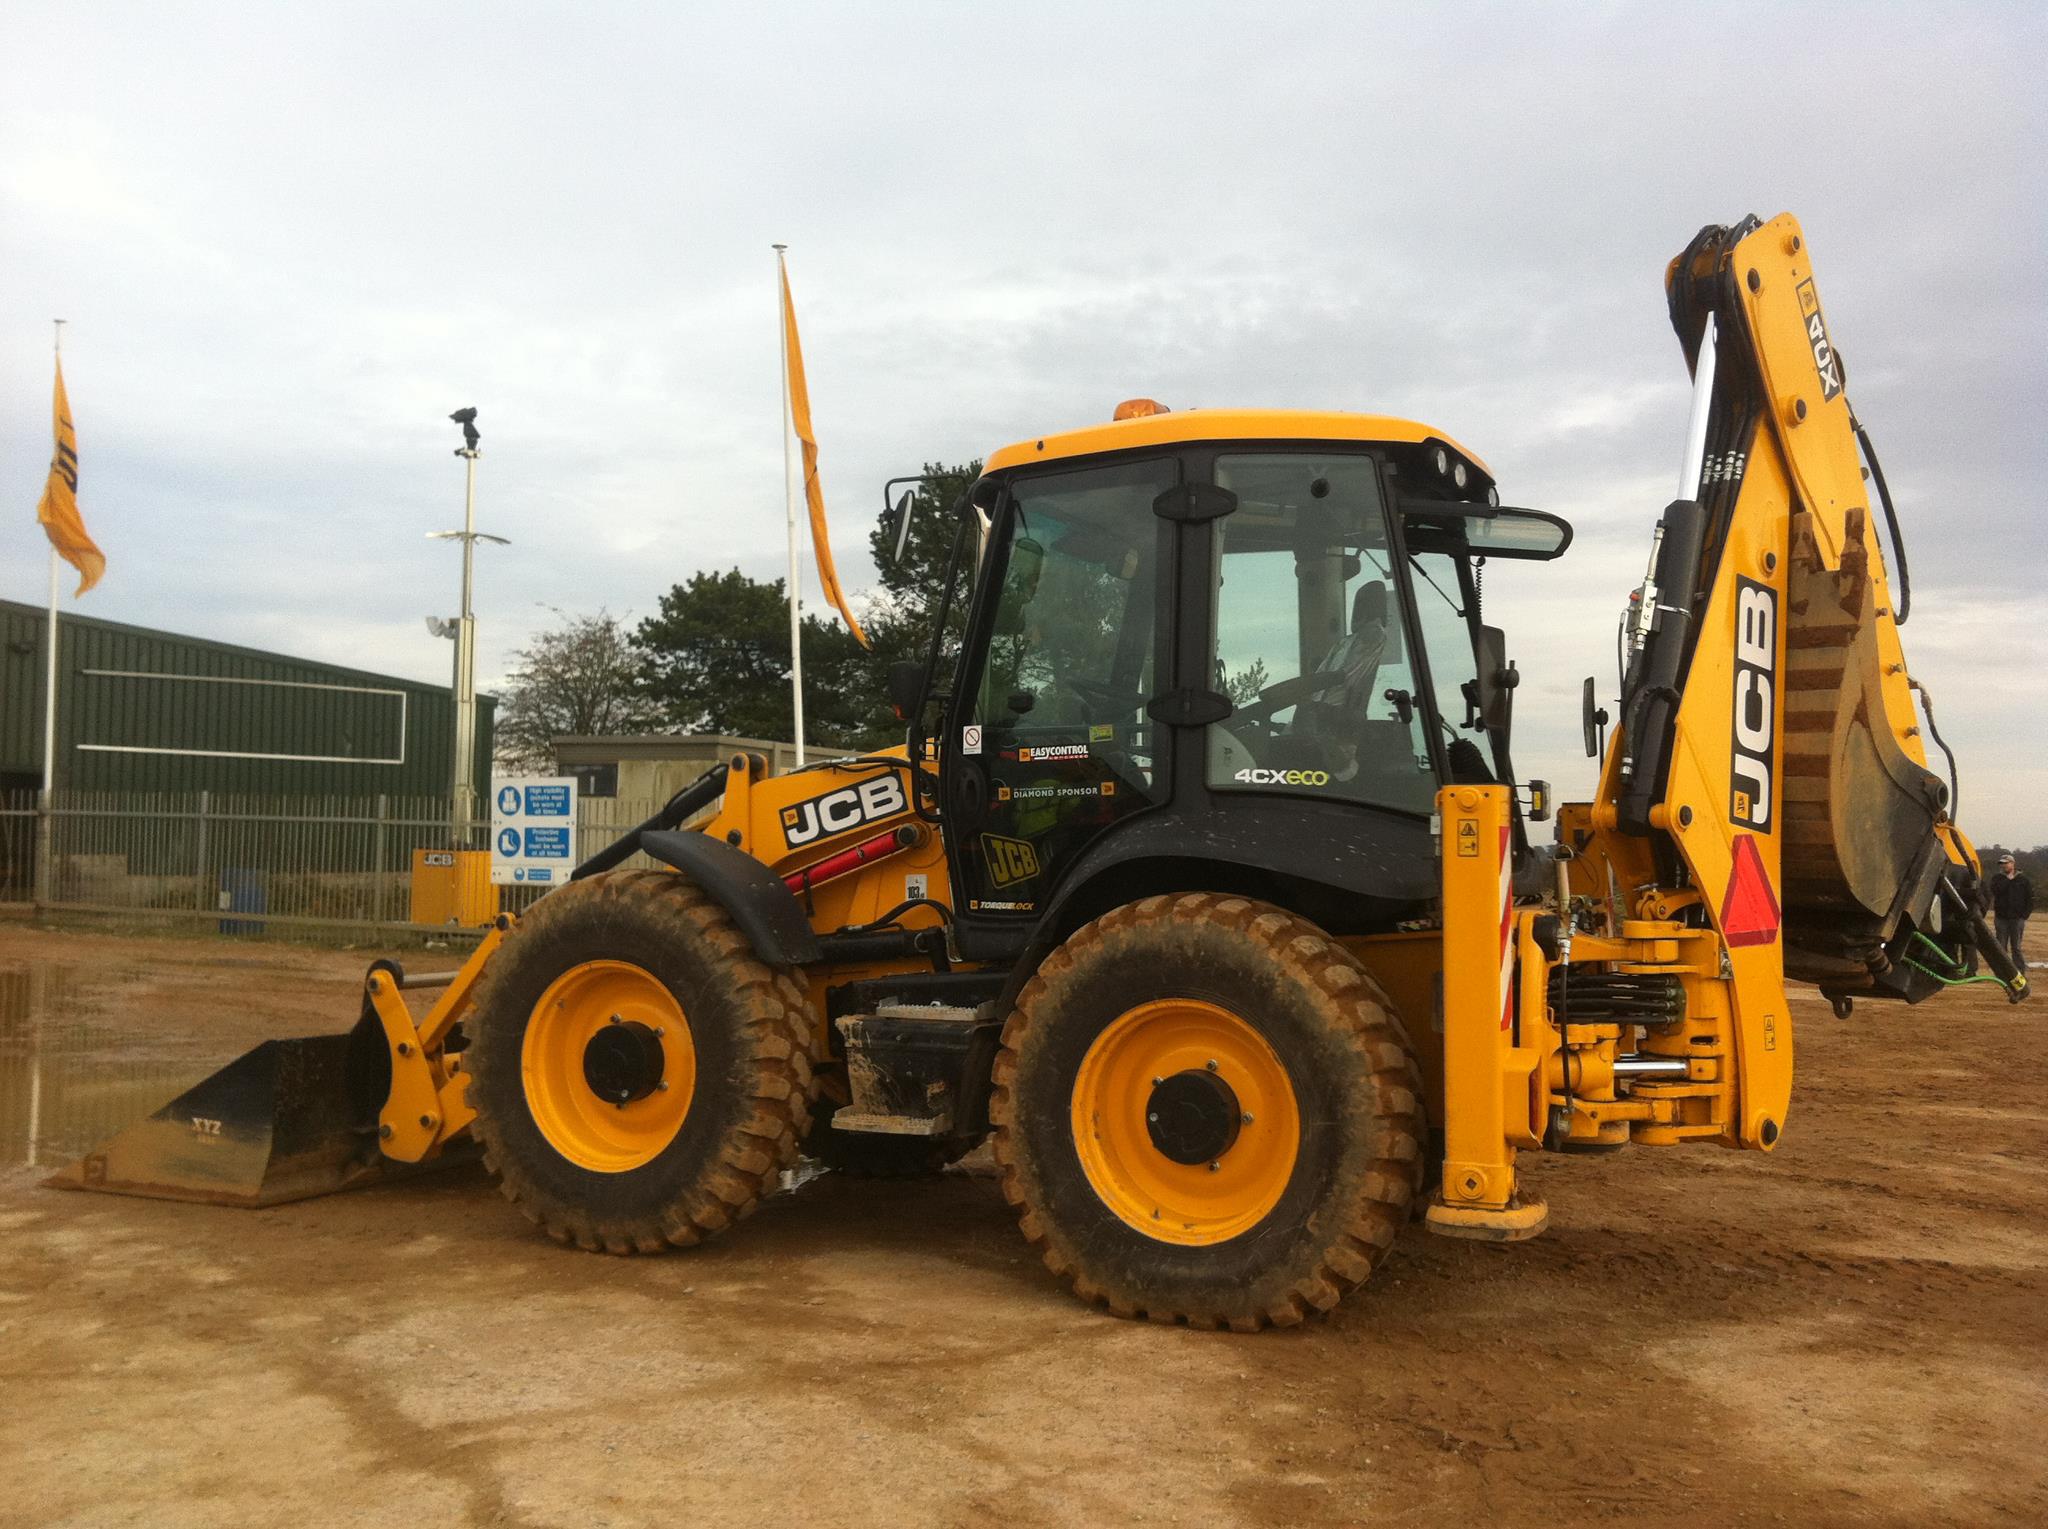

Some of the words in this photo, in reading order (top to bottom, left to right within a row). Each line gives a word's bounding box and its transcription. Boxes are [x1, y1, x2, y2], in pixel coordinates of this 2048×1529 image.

[1808, 313, 1838, 396] 4CX
[1734, 586, 1775, 826] JCB
[1031, 745, 1088, 760] EASYCONTROL
[1234, 769, 1328, 786] 4CXeco
[1013, 789, 1055, 799] DIAMOND
[1057, 787, 1098, 796] SPONSOR
[787, 775, 904, 844] JCB
[424, 854, 453, 865] JCB
[991, 839, 1035, 883] JCB
[907, 886, 920, 899] 103
[980, 901, 1034, 911] TORQUELOCK
